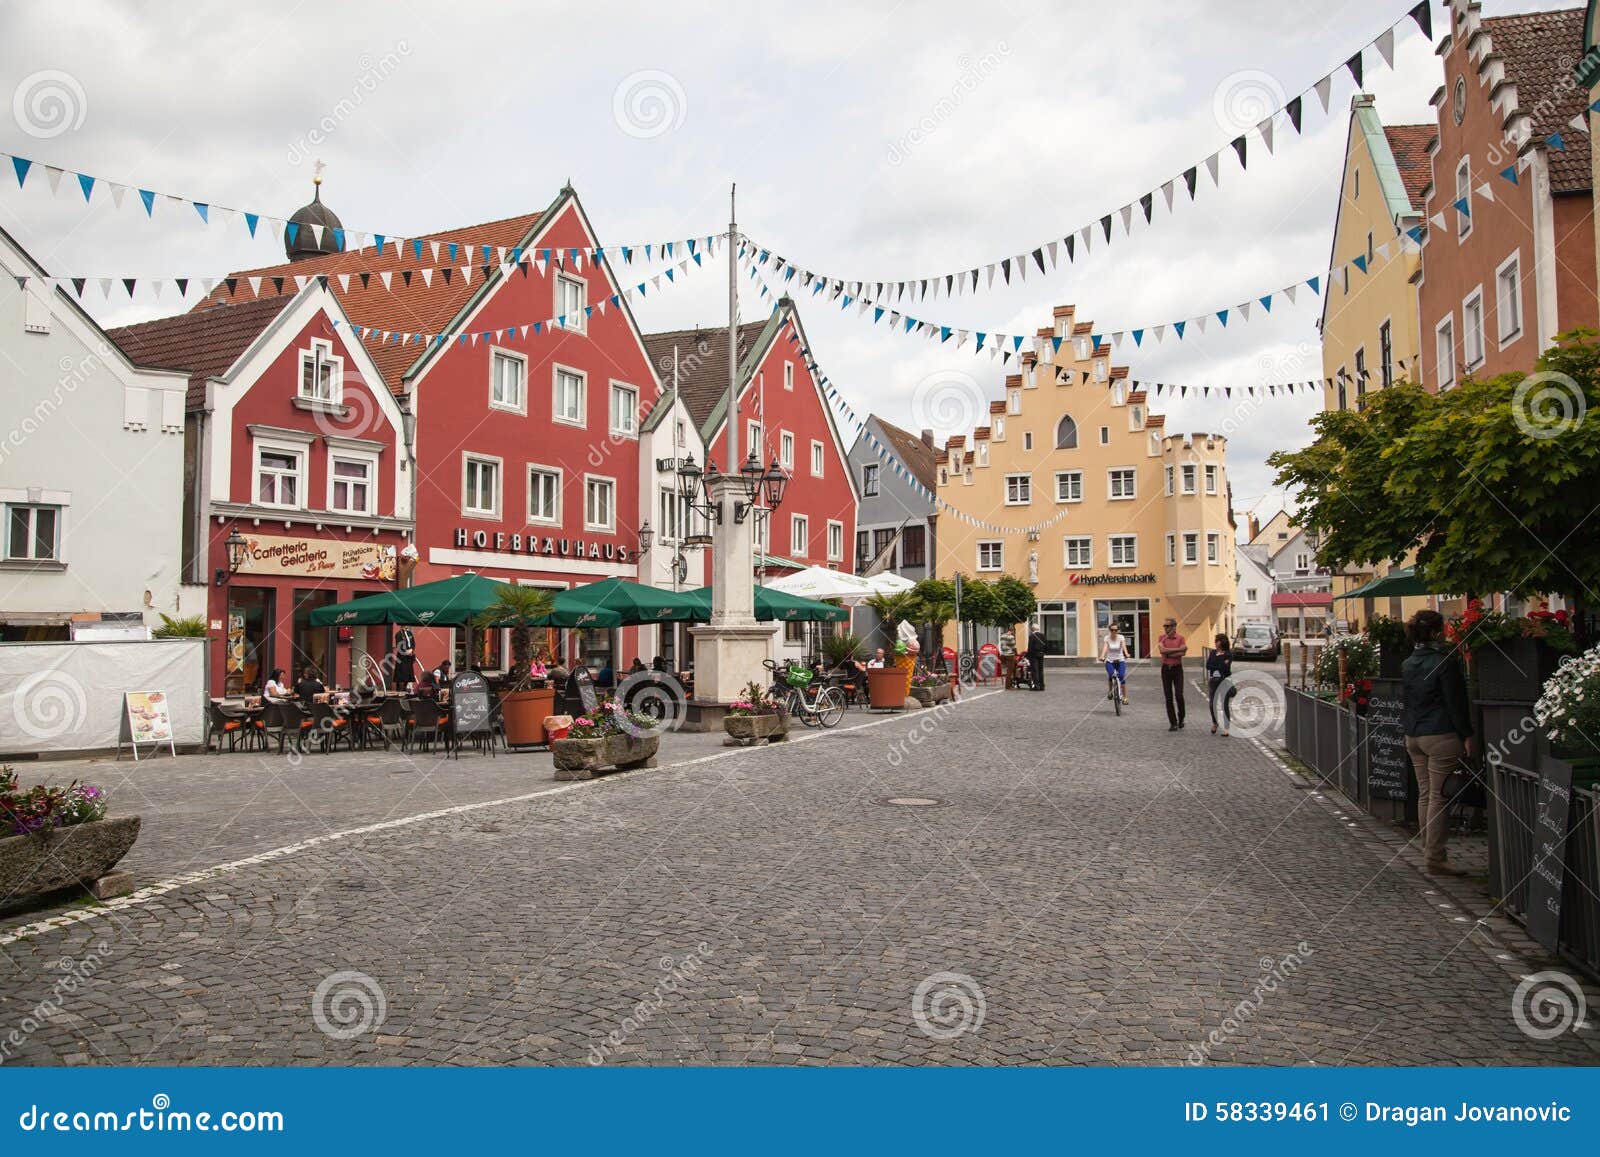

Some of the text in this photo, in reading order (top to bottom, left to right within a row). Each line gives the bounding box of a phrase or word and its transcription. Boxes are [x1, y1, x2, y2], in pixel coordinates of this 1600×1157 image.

[253, 541, 308, 560] Caffetteria
[280, 550, 327, 567] Gelateria
[1080, 573, 1156, 586] HypoVereinsbank
